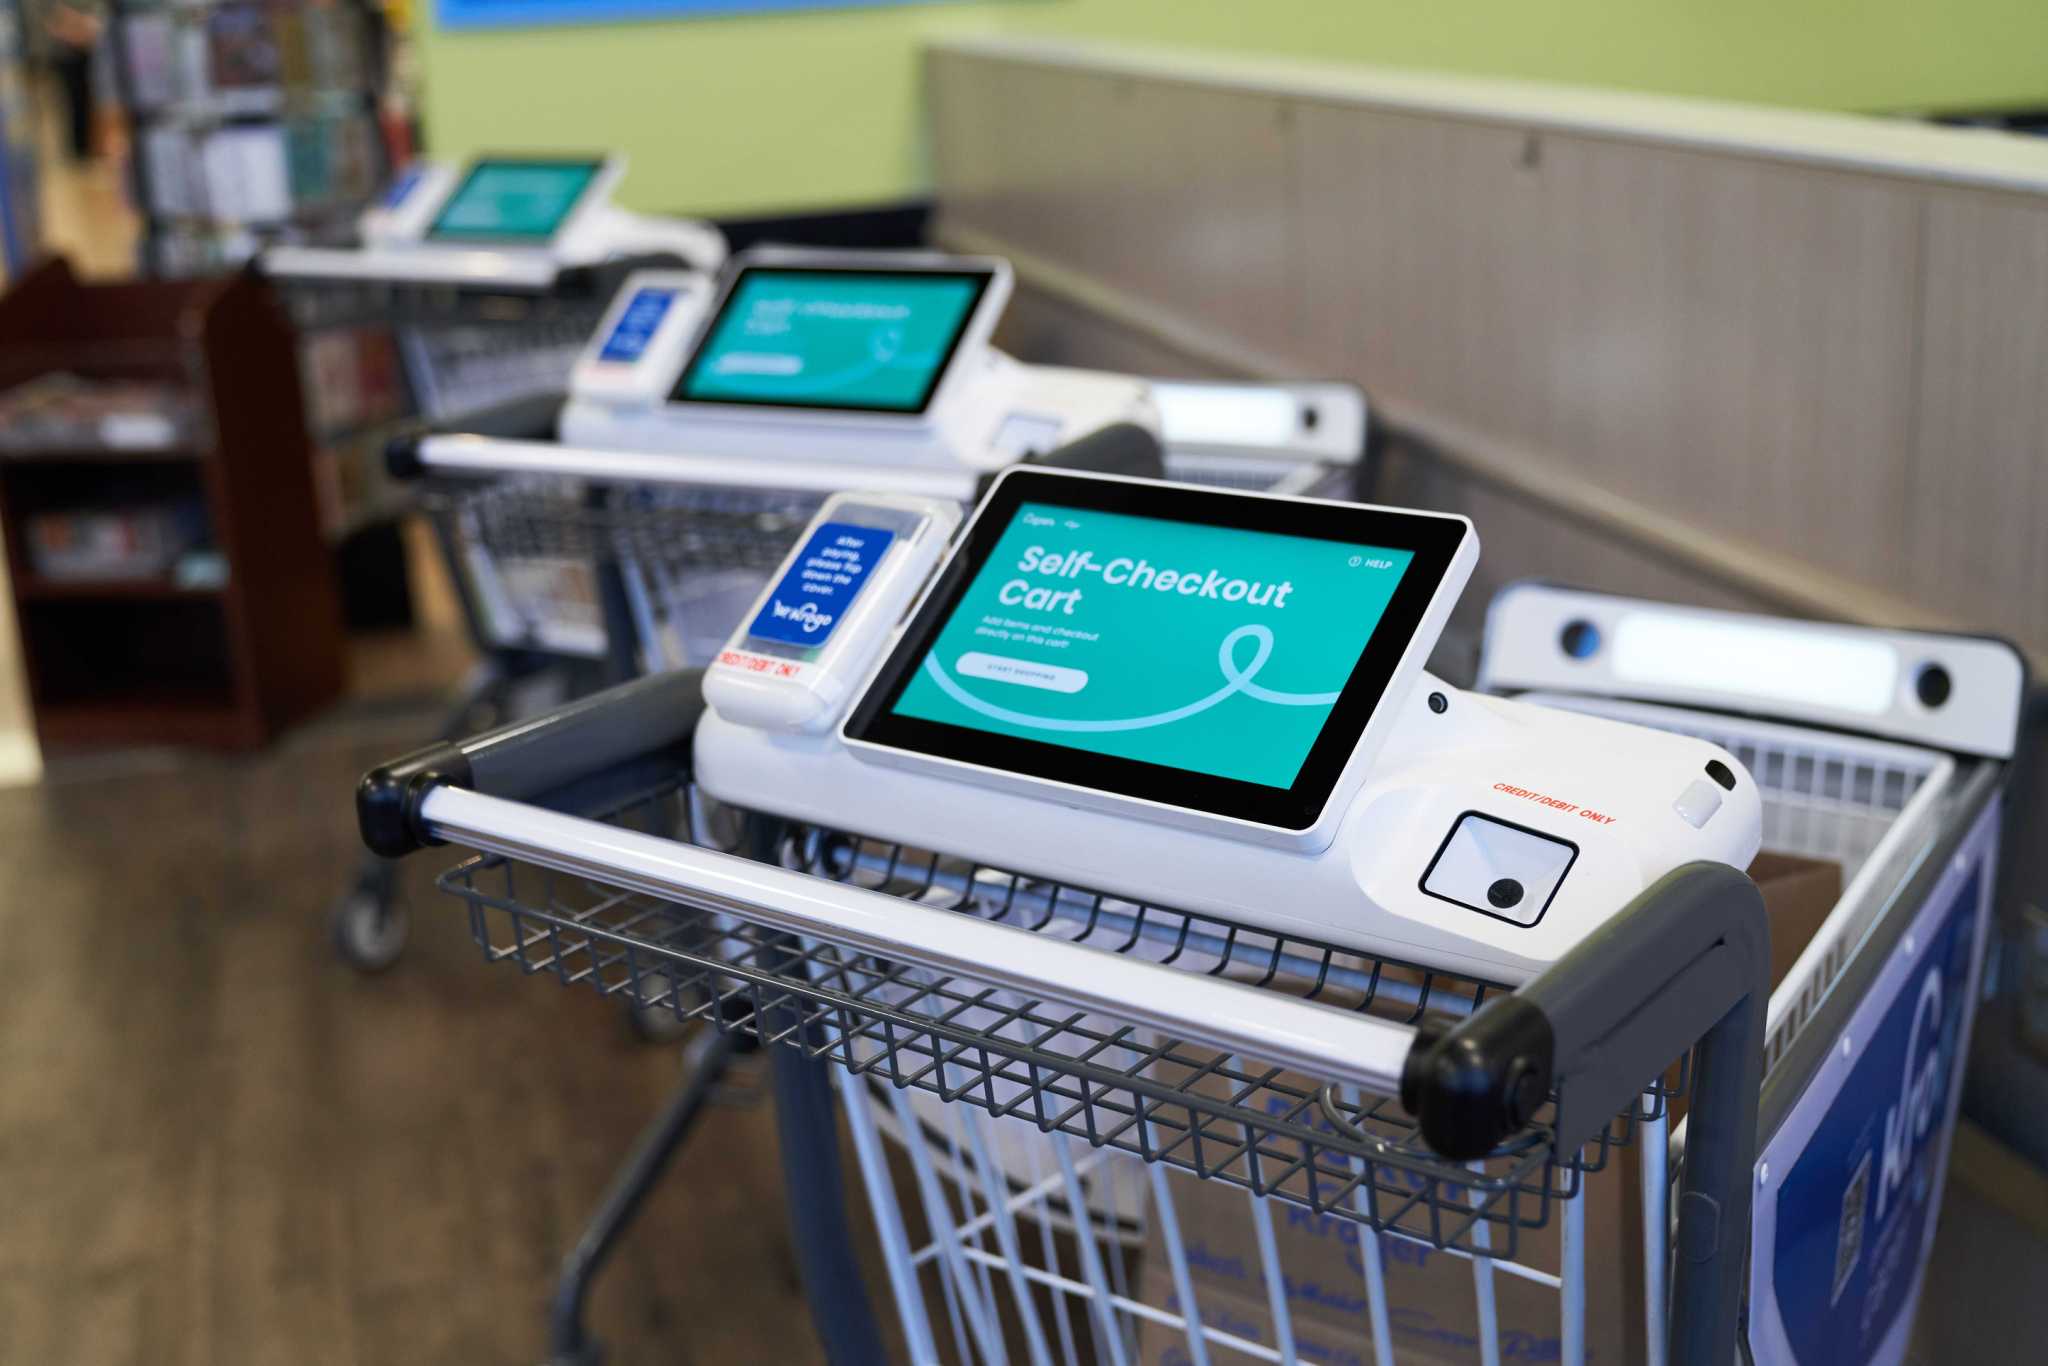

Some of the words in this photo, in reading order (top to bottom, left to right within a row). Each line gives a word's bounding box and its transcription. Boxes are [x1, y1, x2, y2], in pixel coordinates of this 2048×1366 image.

[1018, 545, 1294, 608] Self-Checkout
[1364, 558, 1393, 570] HELP
[999, 579, 1082, 615] Cart
[1493, 783, 1579, 813] CREDIT/DEBIT
[1580, 809, 1617, 825] ONLY
